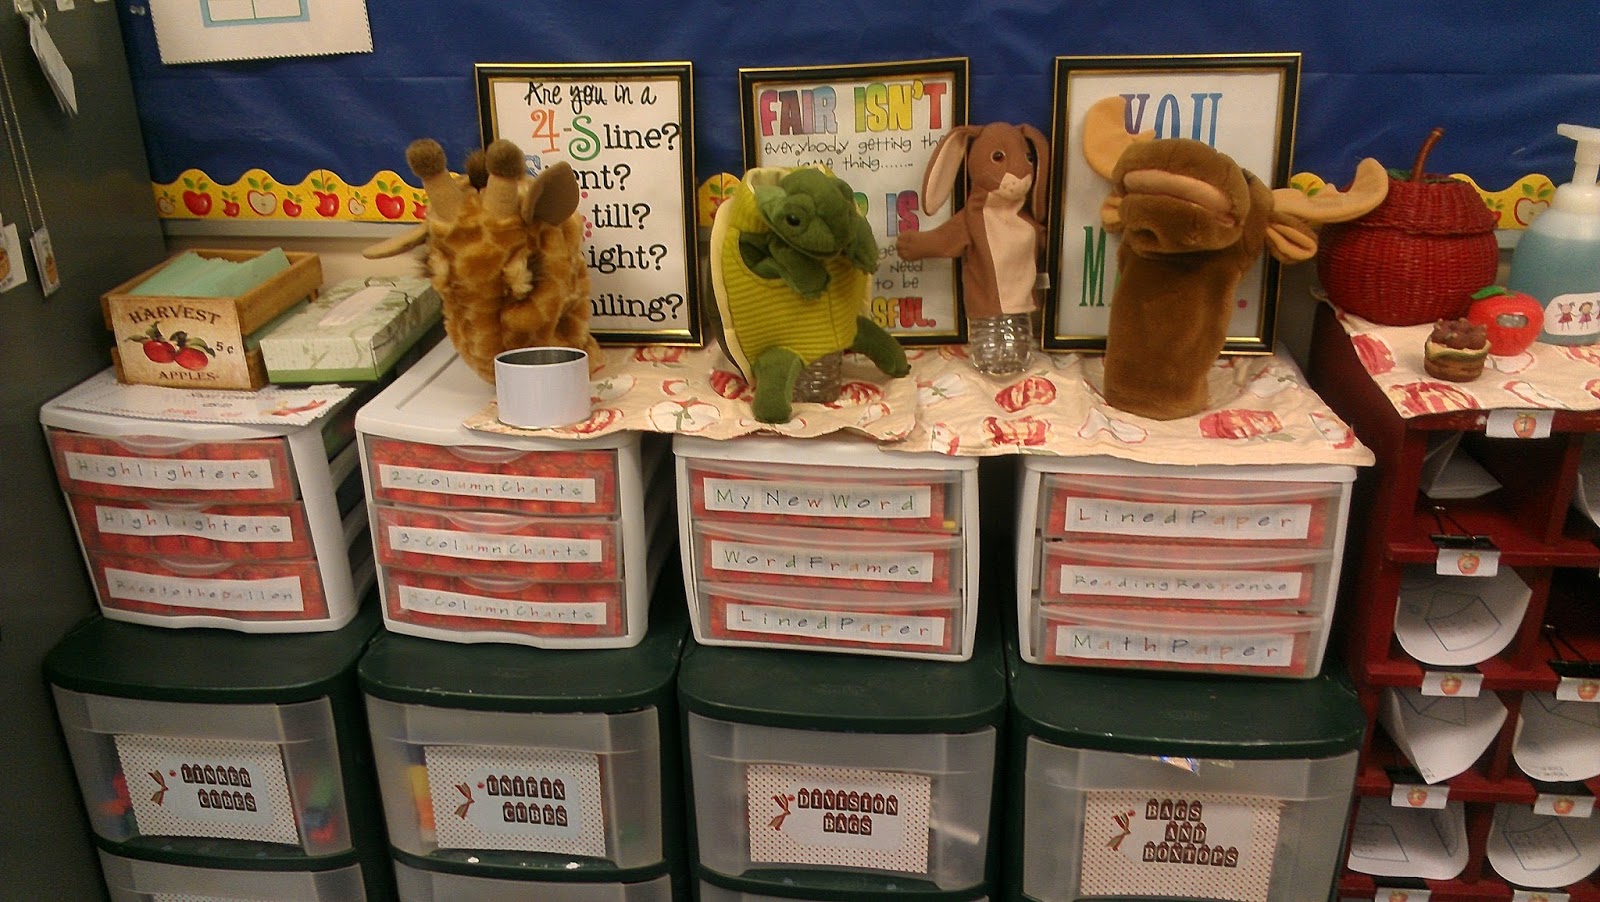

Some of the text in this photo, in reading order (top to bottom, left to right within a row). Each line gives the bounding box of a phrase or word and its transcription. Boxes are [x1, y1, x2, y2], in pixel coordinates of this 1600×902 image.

[524, 81, 657, 115] Are you in a
[759, 80, 947, 137] FAIR ISN'T
[603, 122, 681, 151] line?
[764, 135, 850, 157] everybody
[858, 136, 912, 155] getting
[874, 273, 919, 291] to be
[128, 305, 221, 326] HARVEST
[78, 458, 259, 481] Highlighters
[104, 514, 282, 535] Highlighters
[180, 763, 252, 788] LINKER
[486, 775, 566, 800] UNIFIX
[197, 788, 258, 812] CUBES
[797, 788, 899, 816] DIVISION
[1145, 798, 1203, 821] BAGS
[502, 801, 569, 827] CUBES
[823, 812, 872, 836] BAGS
[1164, 820, 1208, 844] AND
[1143, 841, 1239, 868] BOXTOPS
